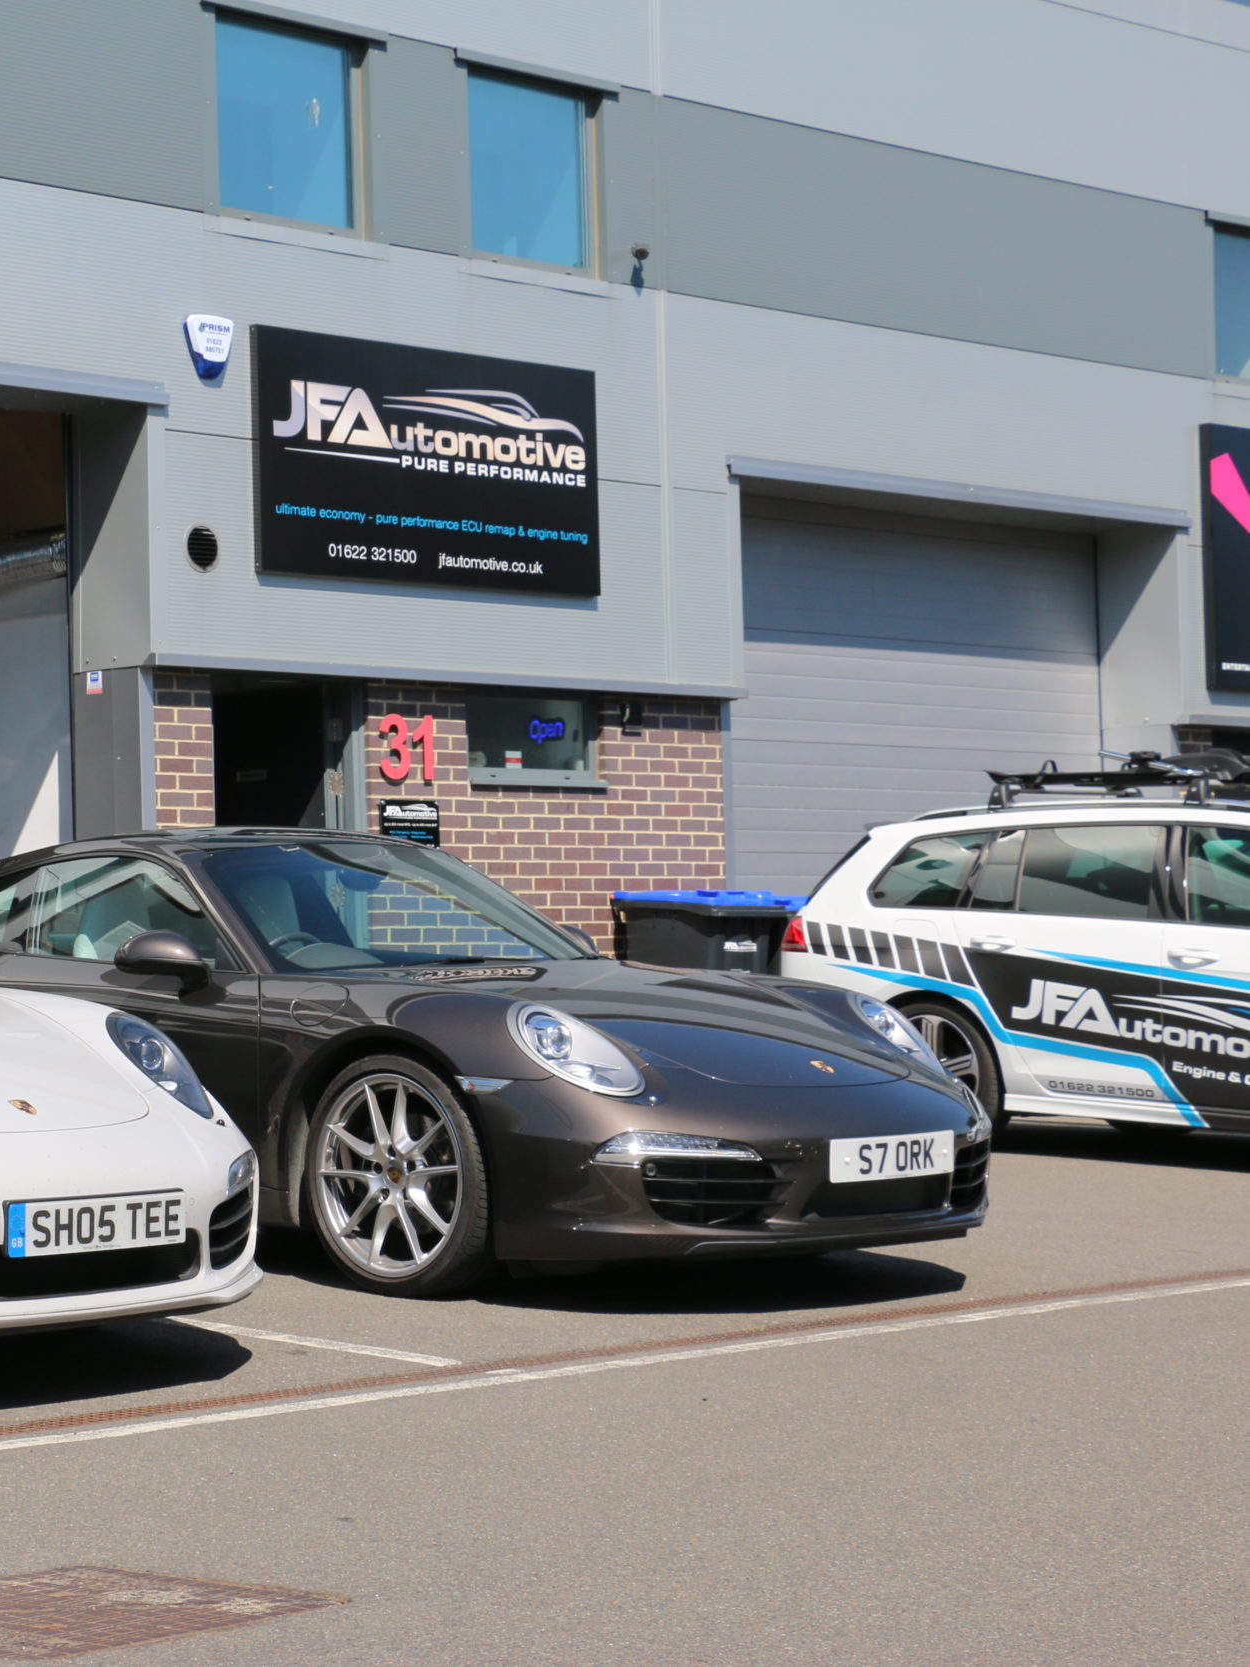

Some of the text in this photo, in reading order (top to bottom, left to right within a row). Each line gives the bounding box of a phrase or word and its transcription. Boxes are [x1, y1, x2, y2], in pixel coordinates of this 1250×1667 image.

[202, 322, 230, 333] PRISM
[272, 379, 587, 471] JFAutomotive
[401, 455, 587, 488] PURE PERFORMANCE
[275, 503, 317, 518] ultimate
[319, 508, 366, 524] economy
[375, 512, 399, 526] pure
[400, 515, 459, 531] performance
[461, 519, 483, 533] ECU
[485, 523, 516, 537] remap
[518, 525, 526, 537] &
[527, 527, 558, 541] engine
[560, 530, 589, 545] tuning
[328, 542, 543, 575] 01622 321500 jfautomotive.co.uk
[378, 713, 435, 780] 31
[529, 719, 565, 745] Open
[1172, 1060, 1226, 1080] Engine
[1228, 1071, 1242, 1084] &
[1049, 1080, 1155, 1098] 01622 321500
[859, 1138, 935, 1175] S7 ORK
[32, 1199, 182, 1249] SH05 TEE
[11, 1237, 23, 1248] GB
